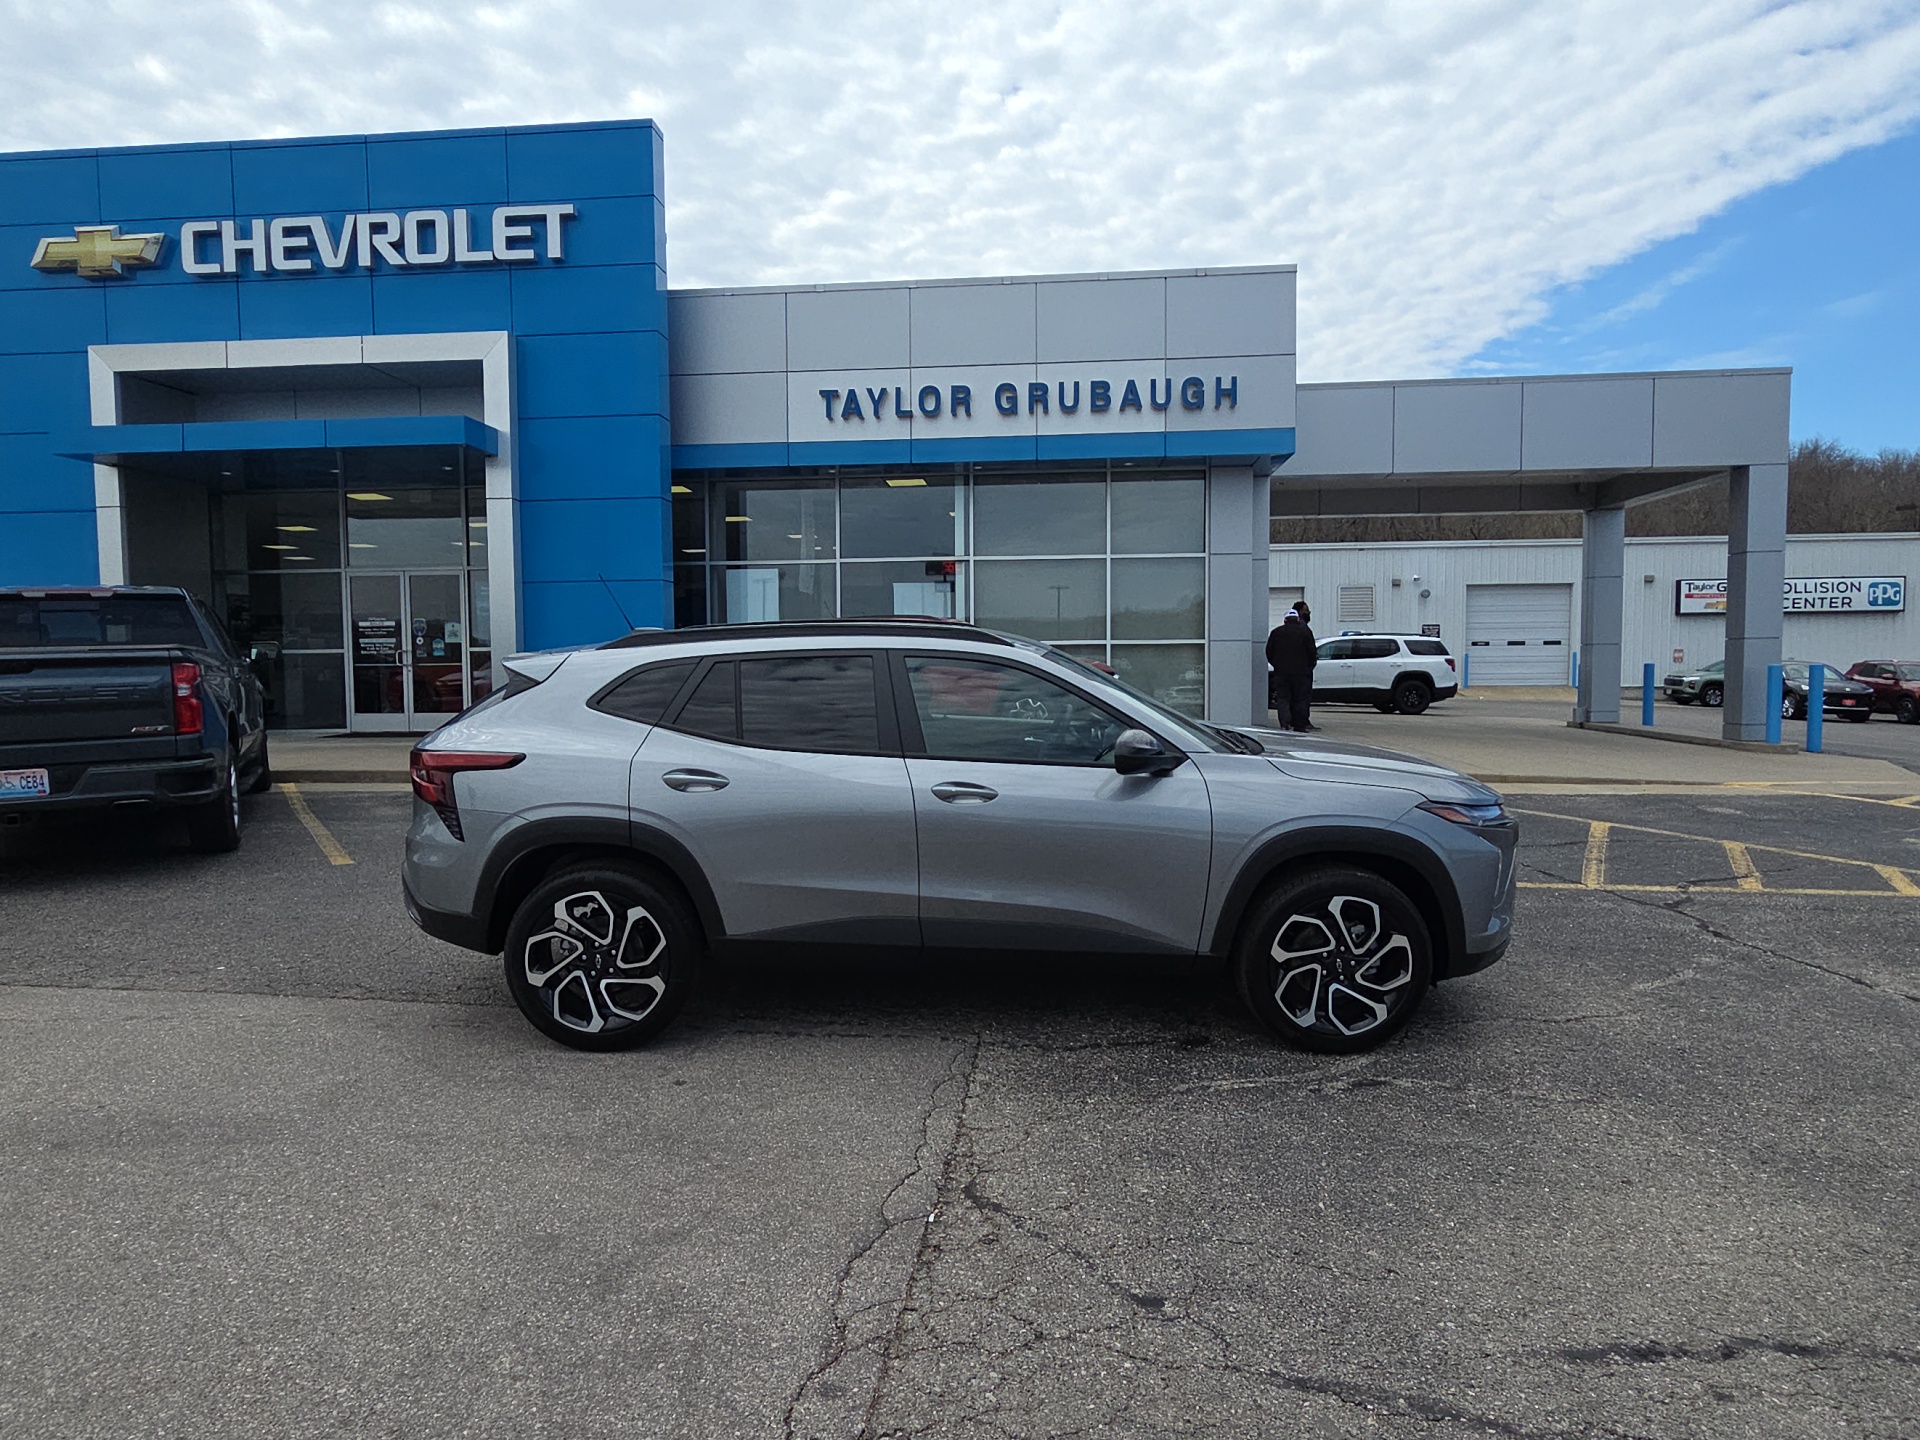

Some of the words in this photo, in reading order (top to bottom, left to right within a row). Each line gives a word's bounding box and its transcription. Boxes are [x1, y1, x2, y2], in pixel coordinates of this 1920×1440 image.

[180, 203, 576, 275] CHEVROLET
[818, 384, 973, 421] TAYLOR
[994, 376, 1239, 416] GRUBAUGH
[1684, 581, 1715, 593] Taylor
[1783, 581, 1862, 594] OLLISION
[1869, 583, 1900, 605] PPG
